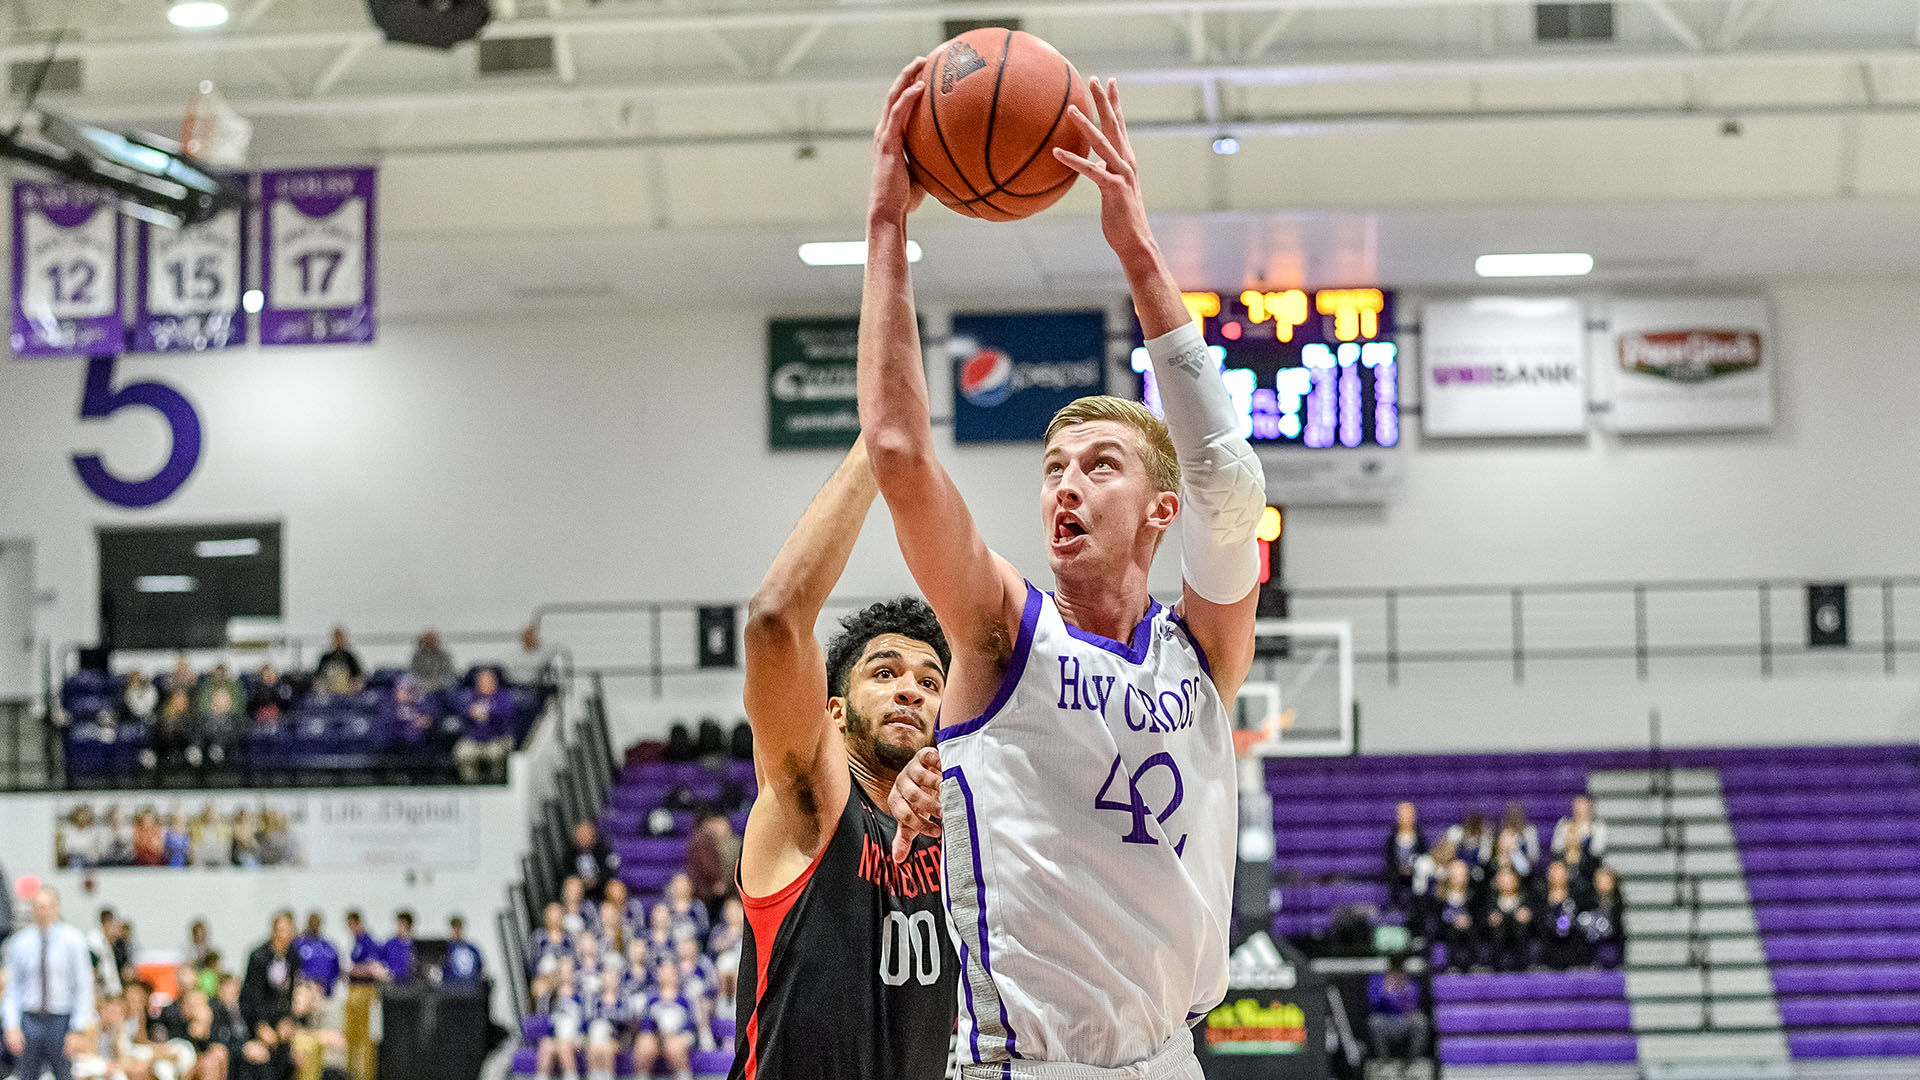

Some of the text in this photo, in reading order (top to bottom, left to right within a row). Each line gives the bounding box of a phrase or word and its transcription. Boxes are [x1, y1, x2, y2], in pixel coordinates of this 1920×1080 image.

[46, 259, 96, 303] 12
[164, 254, 224, 300] 15
[294, 249, 344, 294] 17
[1168, 344, 1205, 366] adidas
[73, 352, 201, 507] 5
[1094, 751, 1188, 859] 42
[879, 910, 941, 986] 00
